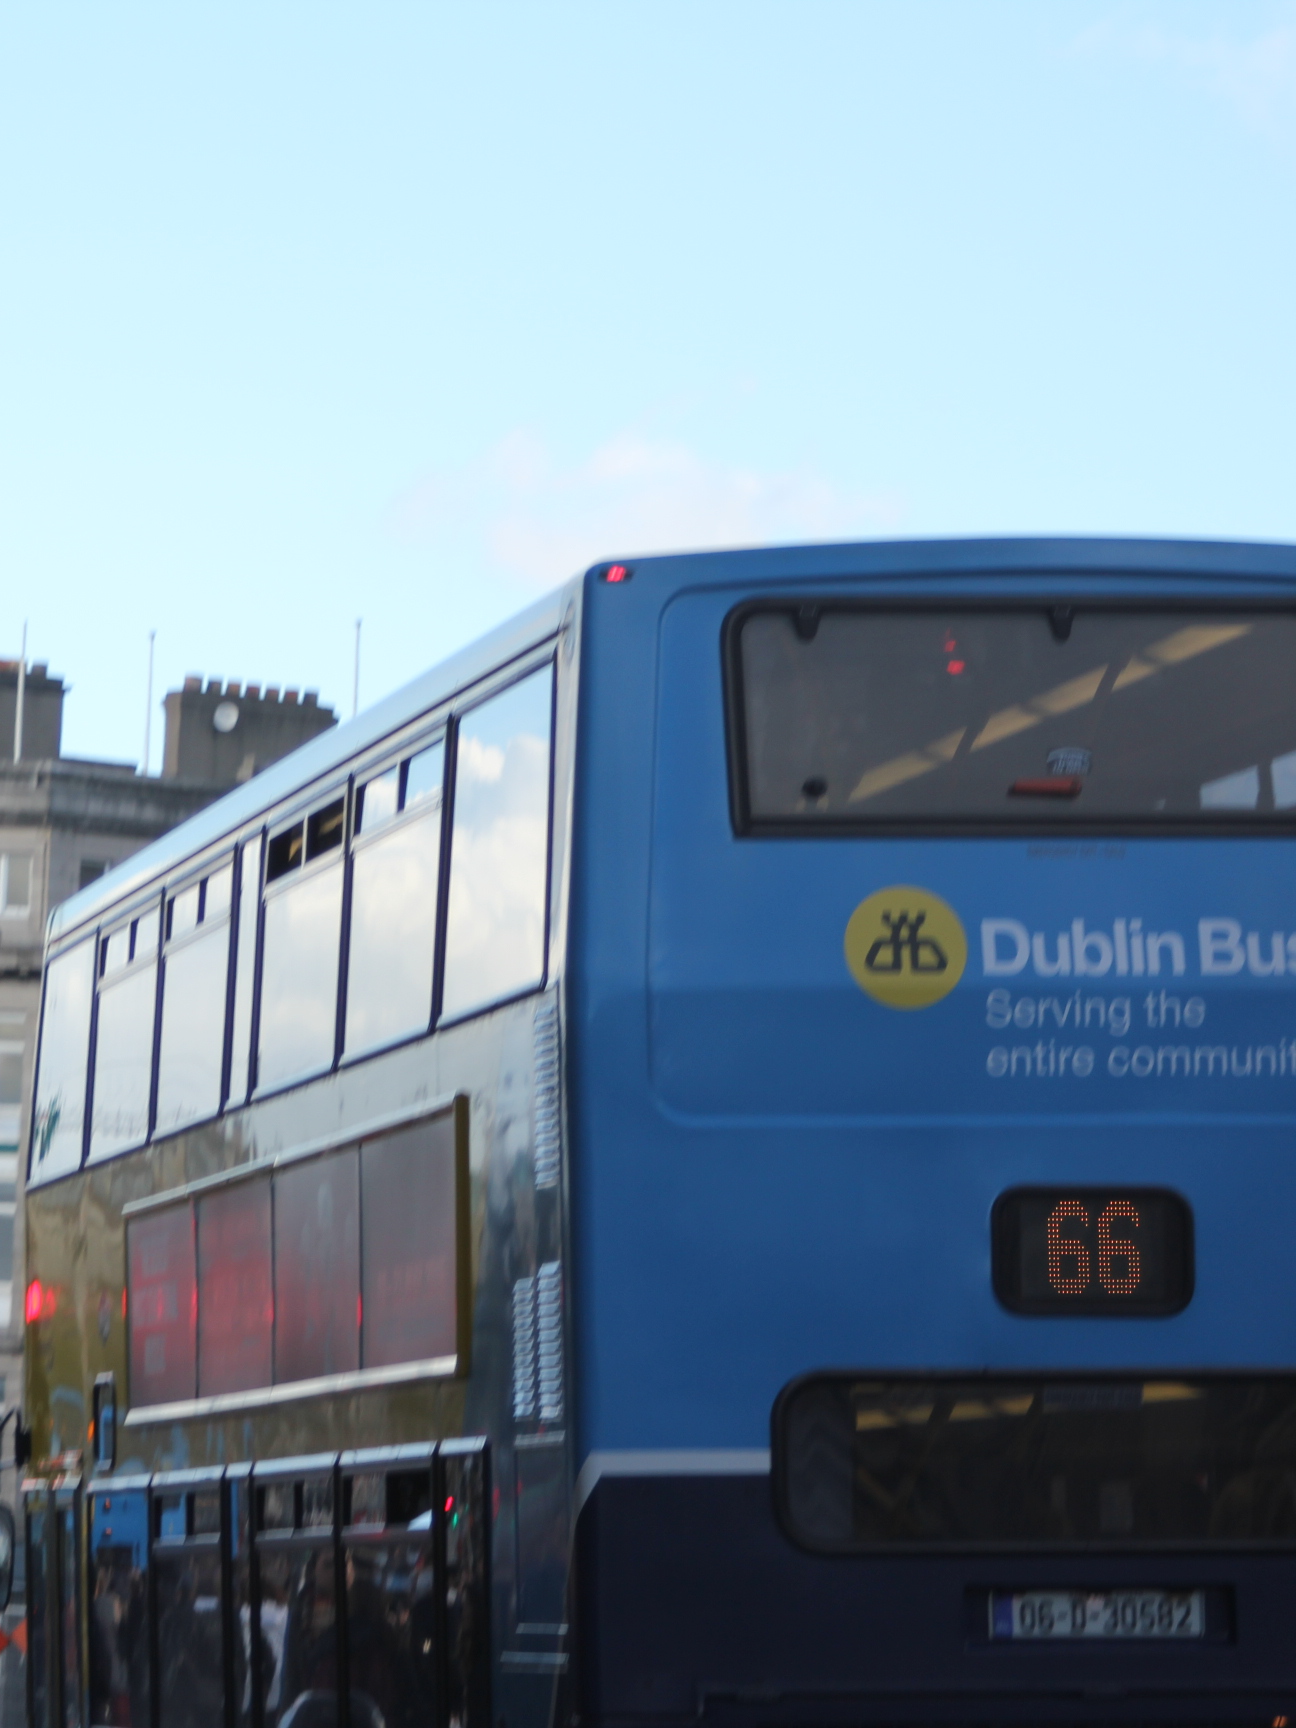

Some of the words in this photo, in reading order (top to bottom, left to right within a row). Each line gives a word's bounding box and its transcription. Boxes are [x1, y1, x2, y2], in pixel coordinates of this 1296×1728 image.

[980, 917, 1186, 977] Dublin
[985, 988, 1131, 1037] Serving
[1144, 988, 1206, 1028] the
[986, 1038, 1095, 1077] entire
[1047, 1201, 1141, 1294] 66
